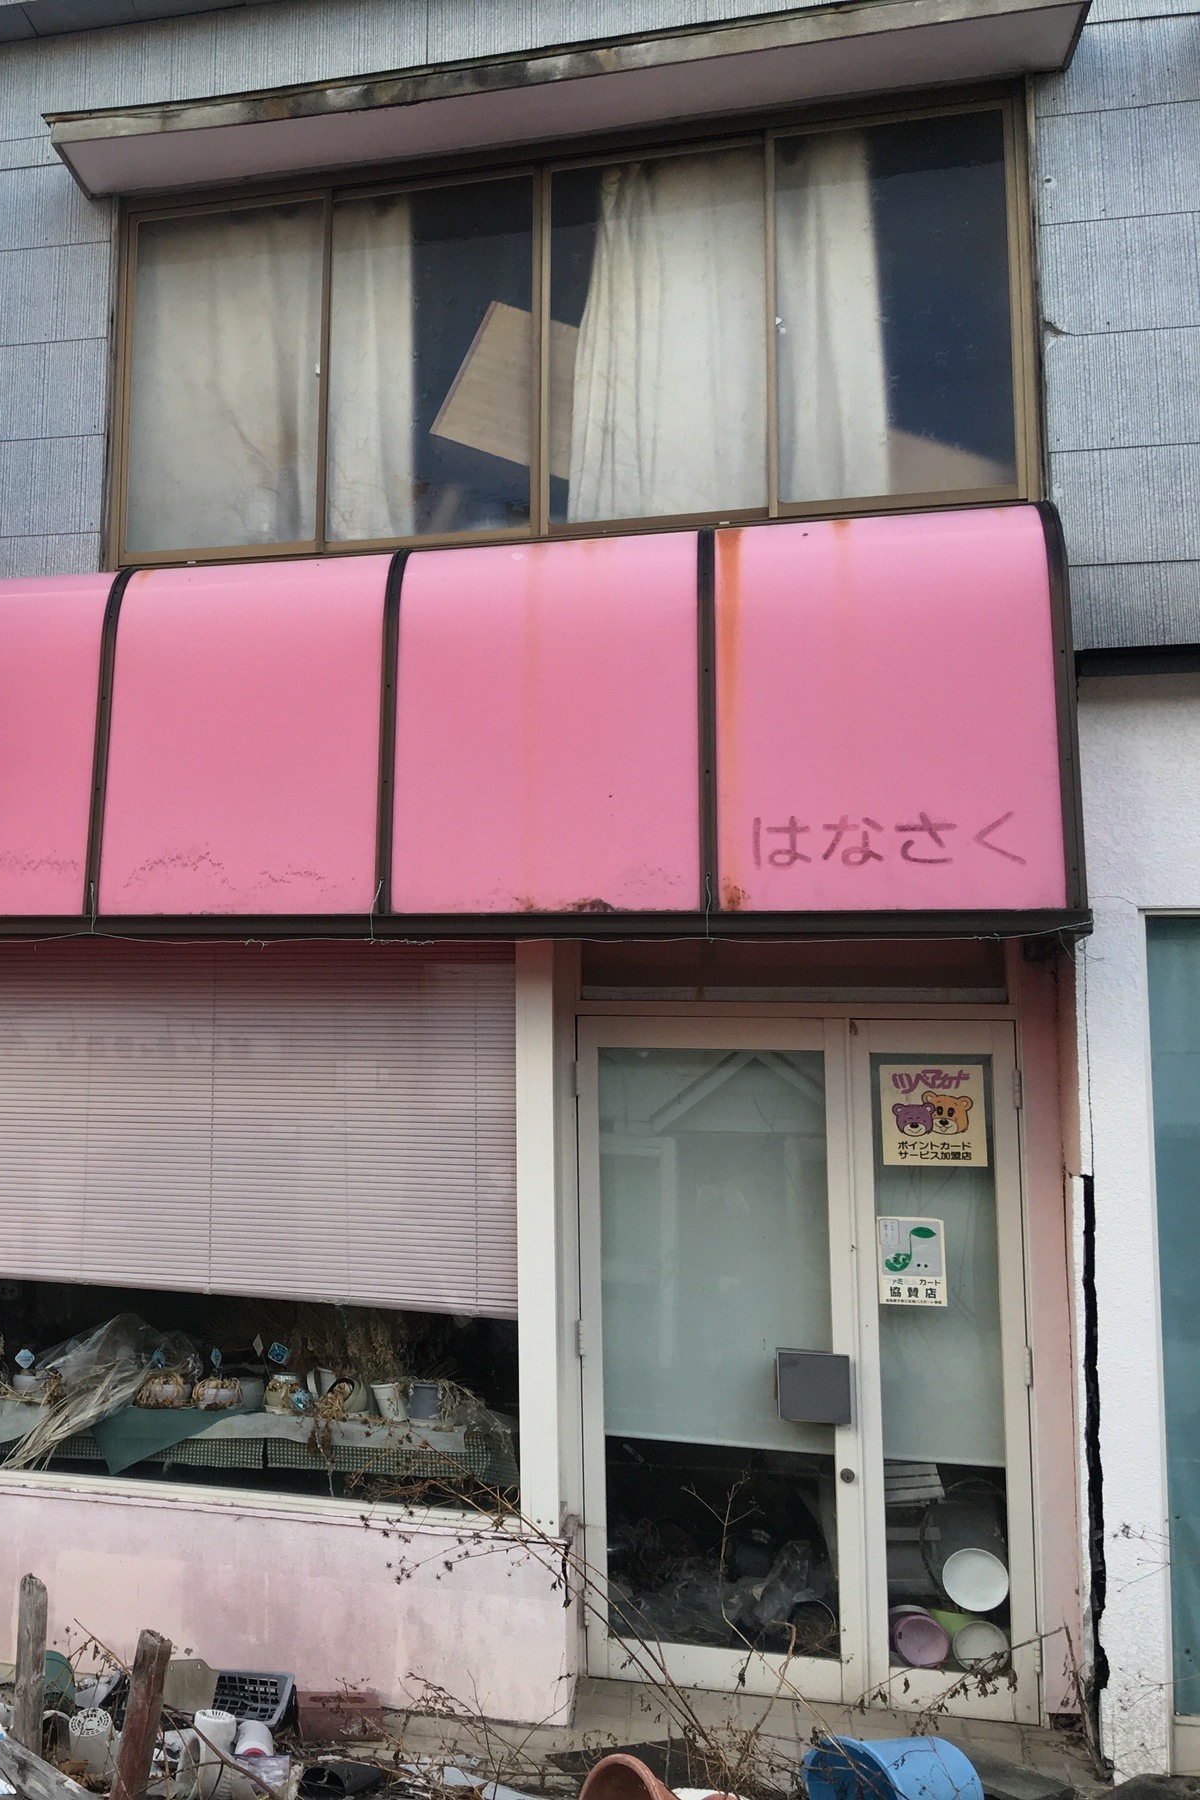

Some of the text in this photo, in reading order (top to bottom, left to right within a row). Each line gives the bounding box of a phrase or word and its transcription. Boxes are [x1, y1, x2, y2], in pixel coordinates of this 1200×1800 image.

[752, 811, 1027, 869] はなさく
[898, 1141, 972, 1151] ポイントカード
[898, 1151, 972, 1160] サービス加盟店
[889, 1286, 937, 1299] 協賛店
